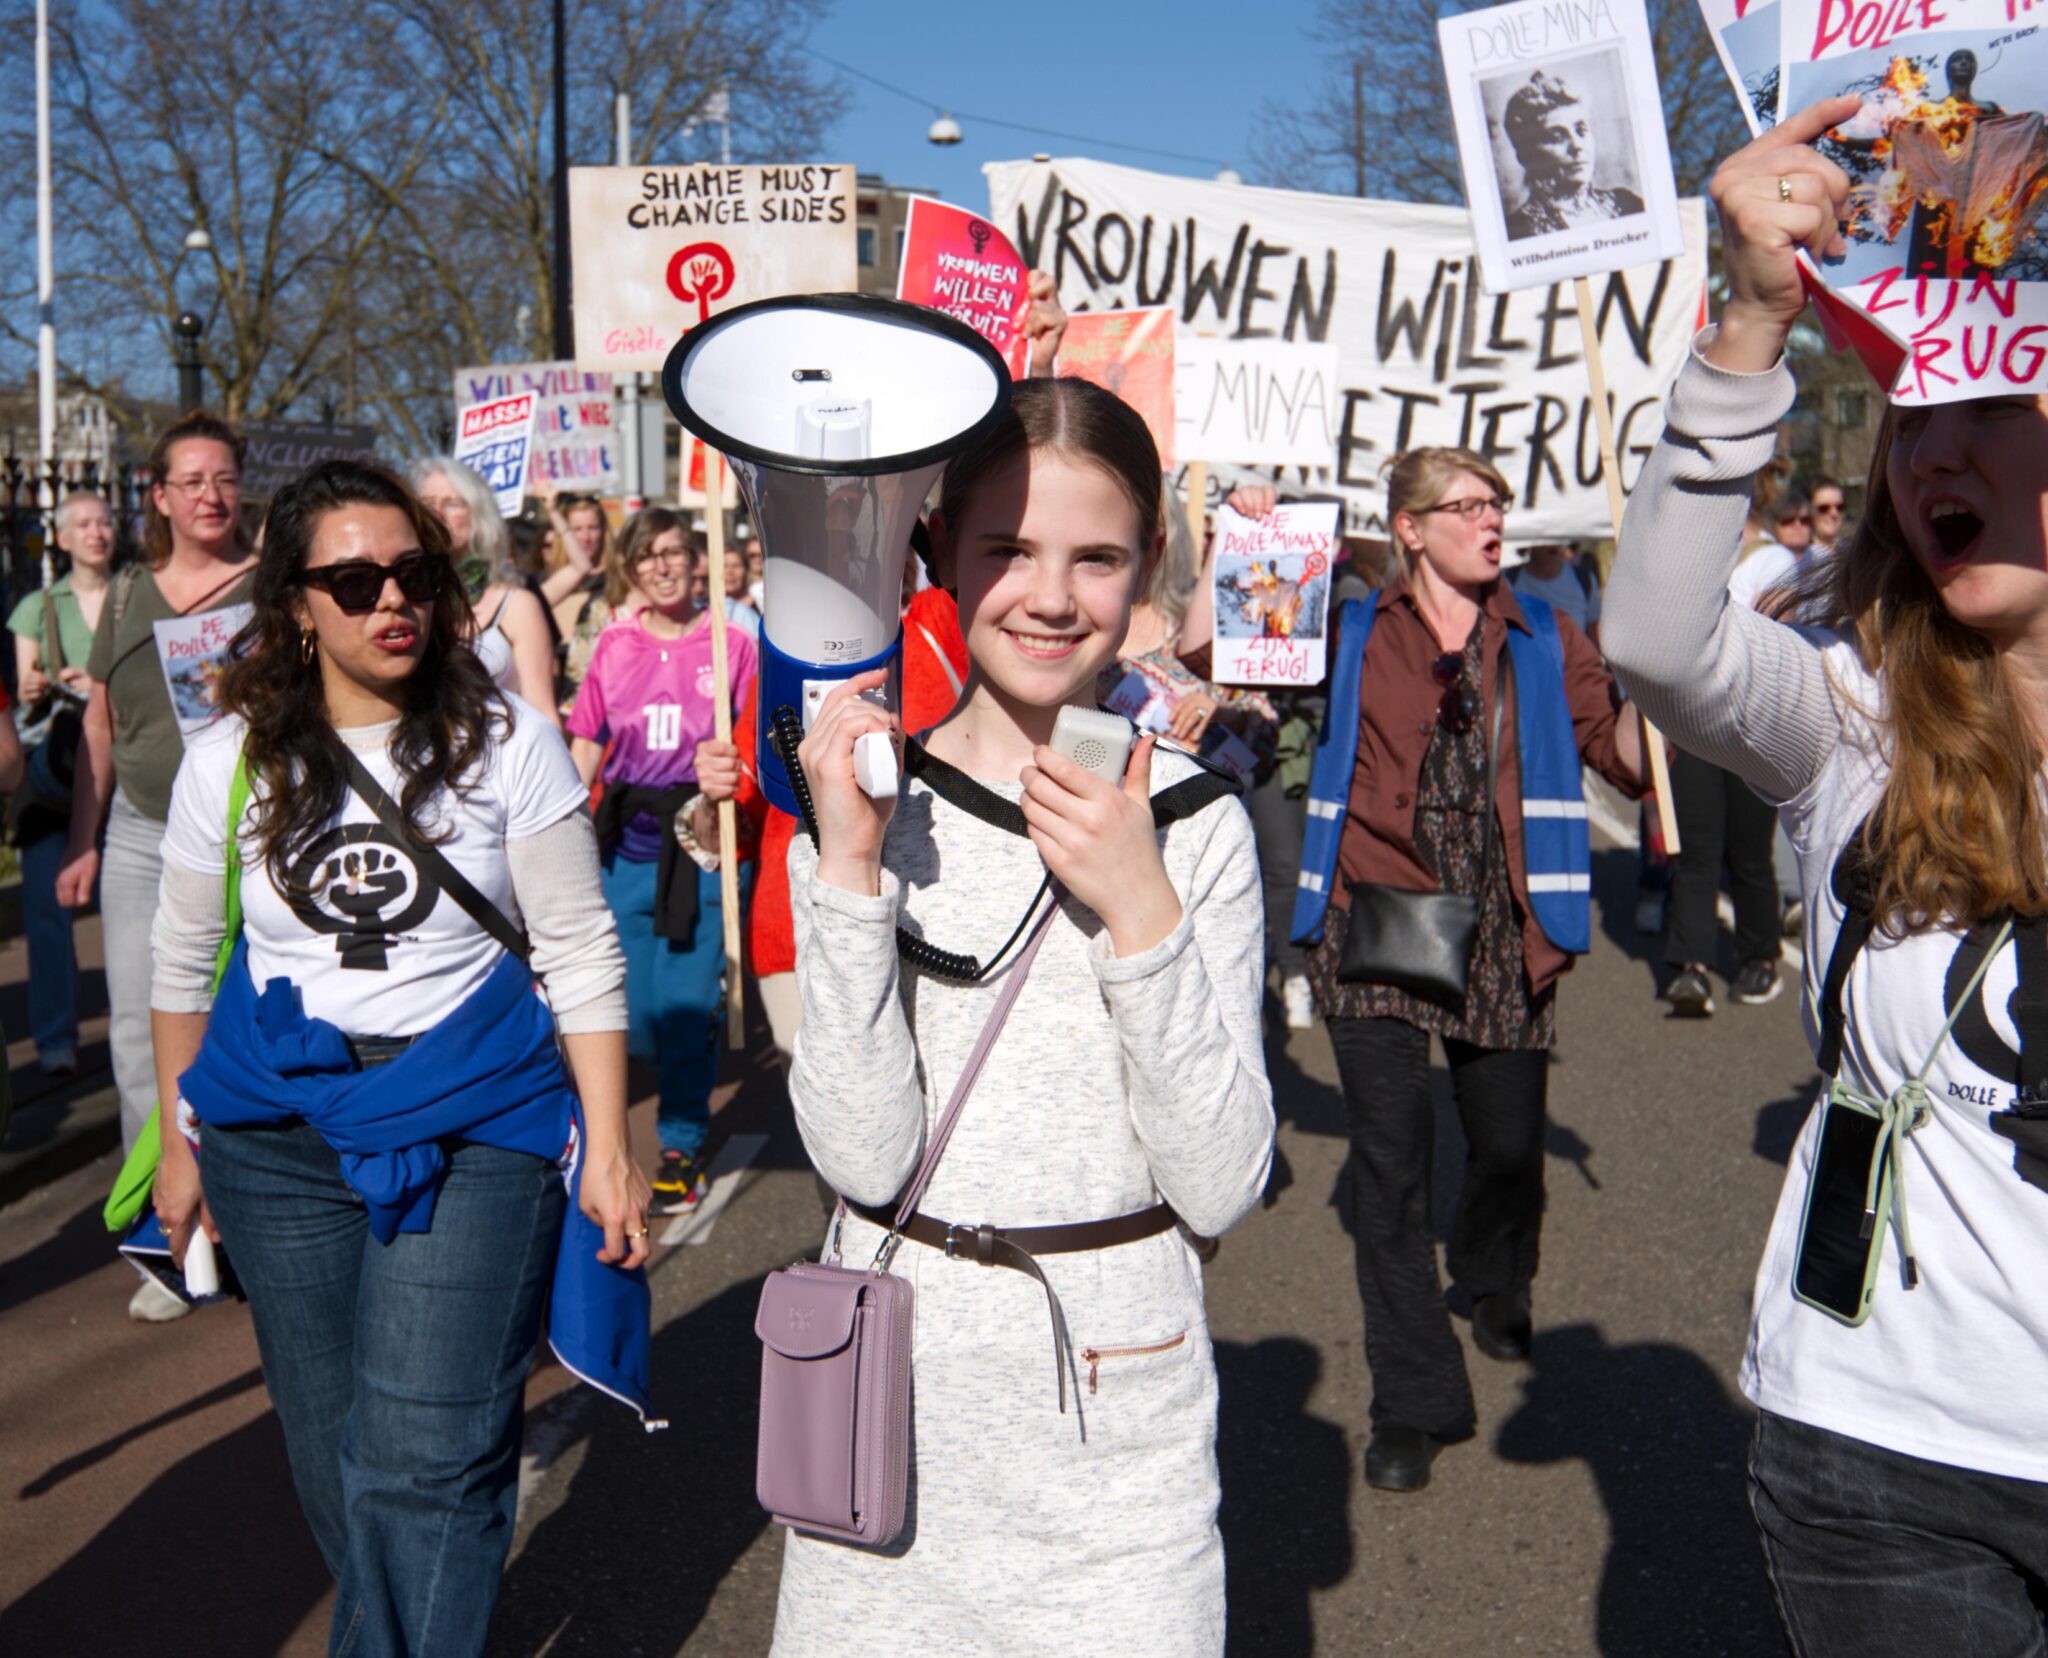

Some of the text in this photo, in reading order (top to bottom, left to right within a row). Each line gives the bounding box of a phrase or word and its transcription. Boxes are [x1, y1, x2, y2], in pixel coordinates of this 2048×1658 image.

[1467, 0, 1618, 67] DOLLE MINA
[1810, 0, 1948, 61] DOLLE
[642, 167, 841, 200] SHAME MUST
[628, 196, 847, 229] CHANGE SIDES
[1017, 171, 1337, 343] VROUWEN
[1511, 231, 1649, 268] Wilhelmina Drucker
[938, 253, 1019, 285] VROUWEN
[605, 325, 666, 354] Gisèle
[1894, 322, 2048, 400] RUG
[463, 399, 529, 435] MASSA
[1201, 360, 1333, 447] MINA
[1450, 380, 1660, 509] TERUG
[1262, 512, 1290, 529] DE
[1223, 532, 1268, 556] DOLLE
[201, 617, 224, 635] DE
[168, 636, 212, 659] DOLLE
[1233, 649, 1309, 682] TERUG!
[643, 704, 682, 750] 10
[1948, 1081, 1997, 1106] DOLLE
